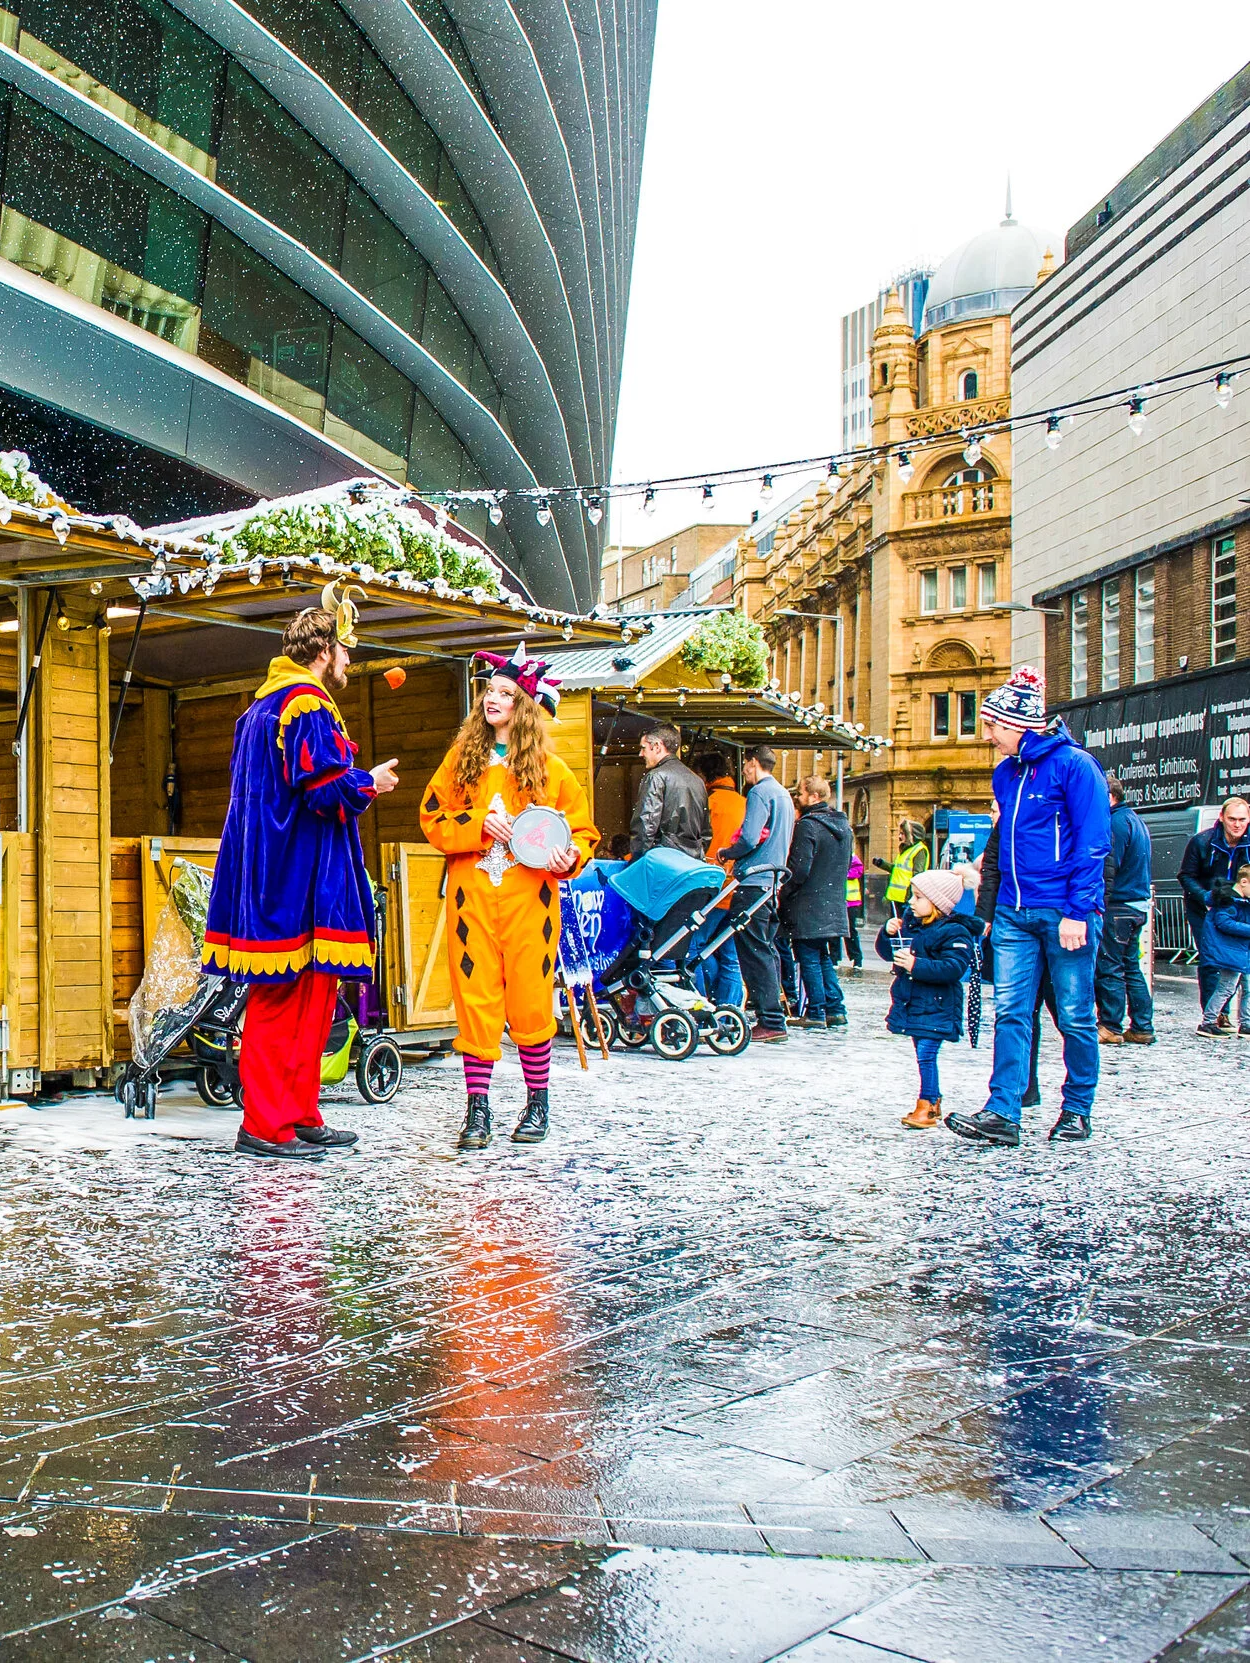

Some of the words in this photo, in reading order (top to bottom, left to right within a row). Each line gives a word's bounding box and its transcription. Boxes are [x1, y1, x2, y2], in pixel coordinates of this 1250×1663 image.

[1141, 722, 1158, 742] your
[1210, 735, 1231, 760] 0870
[1233, 733, 1250, 758] 600
[1118, 762, 1158, 780] Conferences,
[1160, 757, 1199, 776] Exhibitions,
[1144, 784, 1150, 801] &
[1152, 782, 1176, 804] Special
[1178, 780, 1201, 799] Events
[572, 890, 604, 913] now
